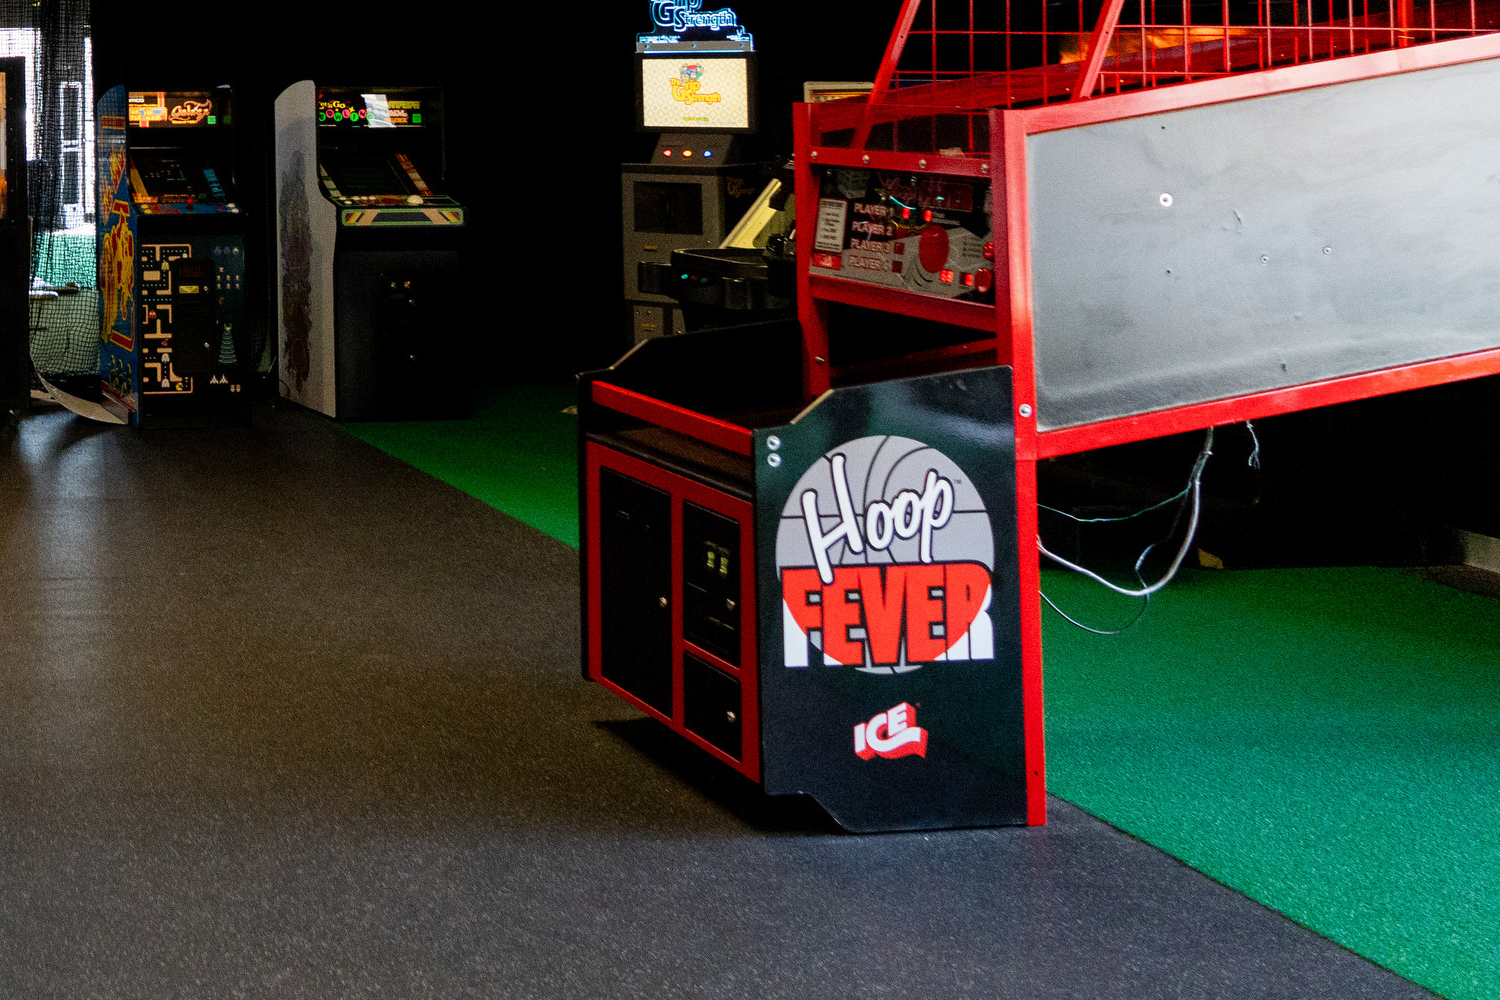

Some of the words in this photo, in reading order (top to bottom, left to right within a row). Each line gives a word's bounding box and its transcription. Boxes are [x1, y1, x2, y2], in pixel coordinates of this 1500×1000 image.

[674, 6, 737, 31] Strength
[332, 100, 346, 109] Go
[685, 89, 721, 105] Strength
[853, 202, 887, 216] PLAYER
[851, 221, 885, 235] PLAYER
[850, 238, 883, 252] PLAYER
[801, 452, 956, 585] Hoop
[781, 562, 995, 668] FEVER
[853, 702, 928, 759] ICE
